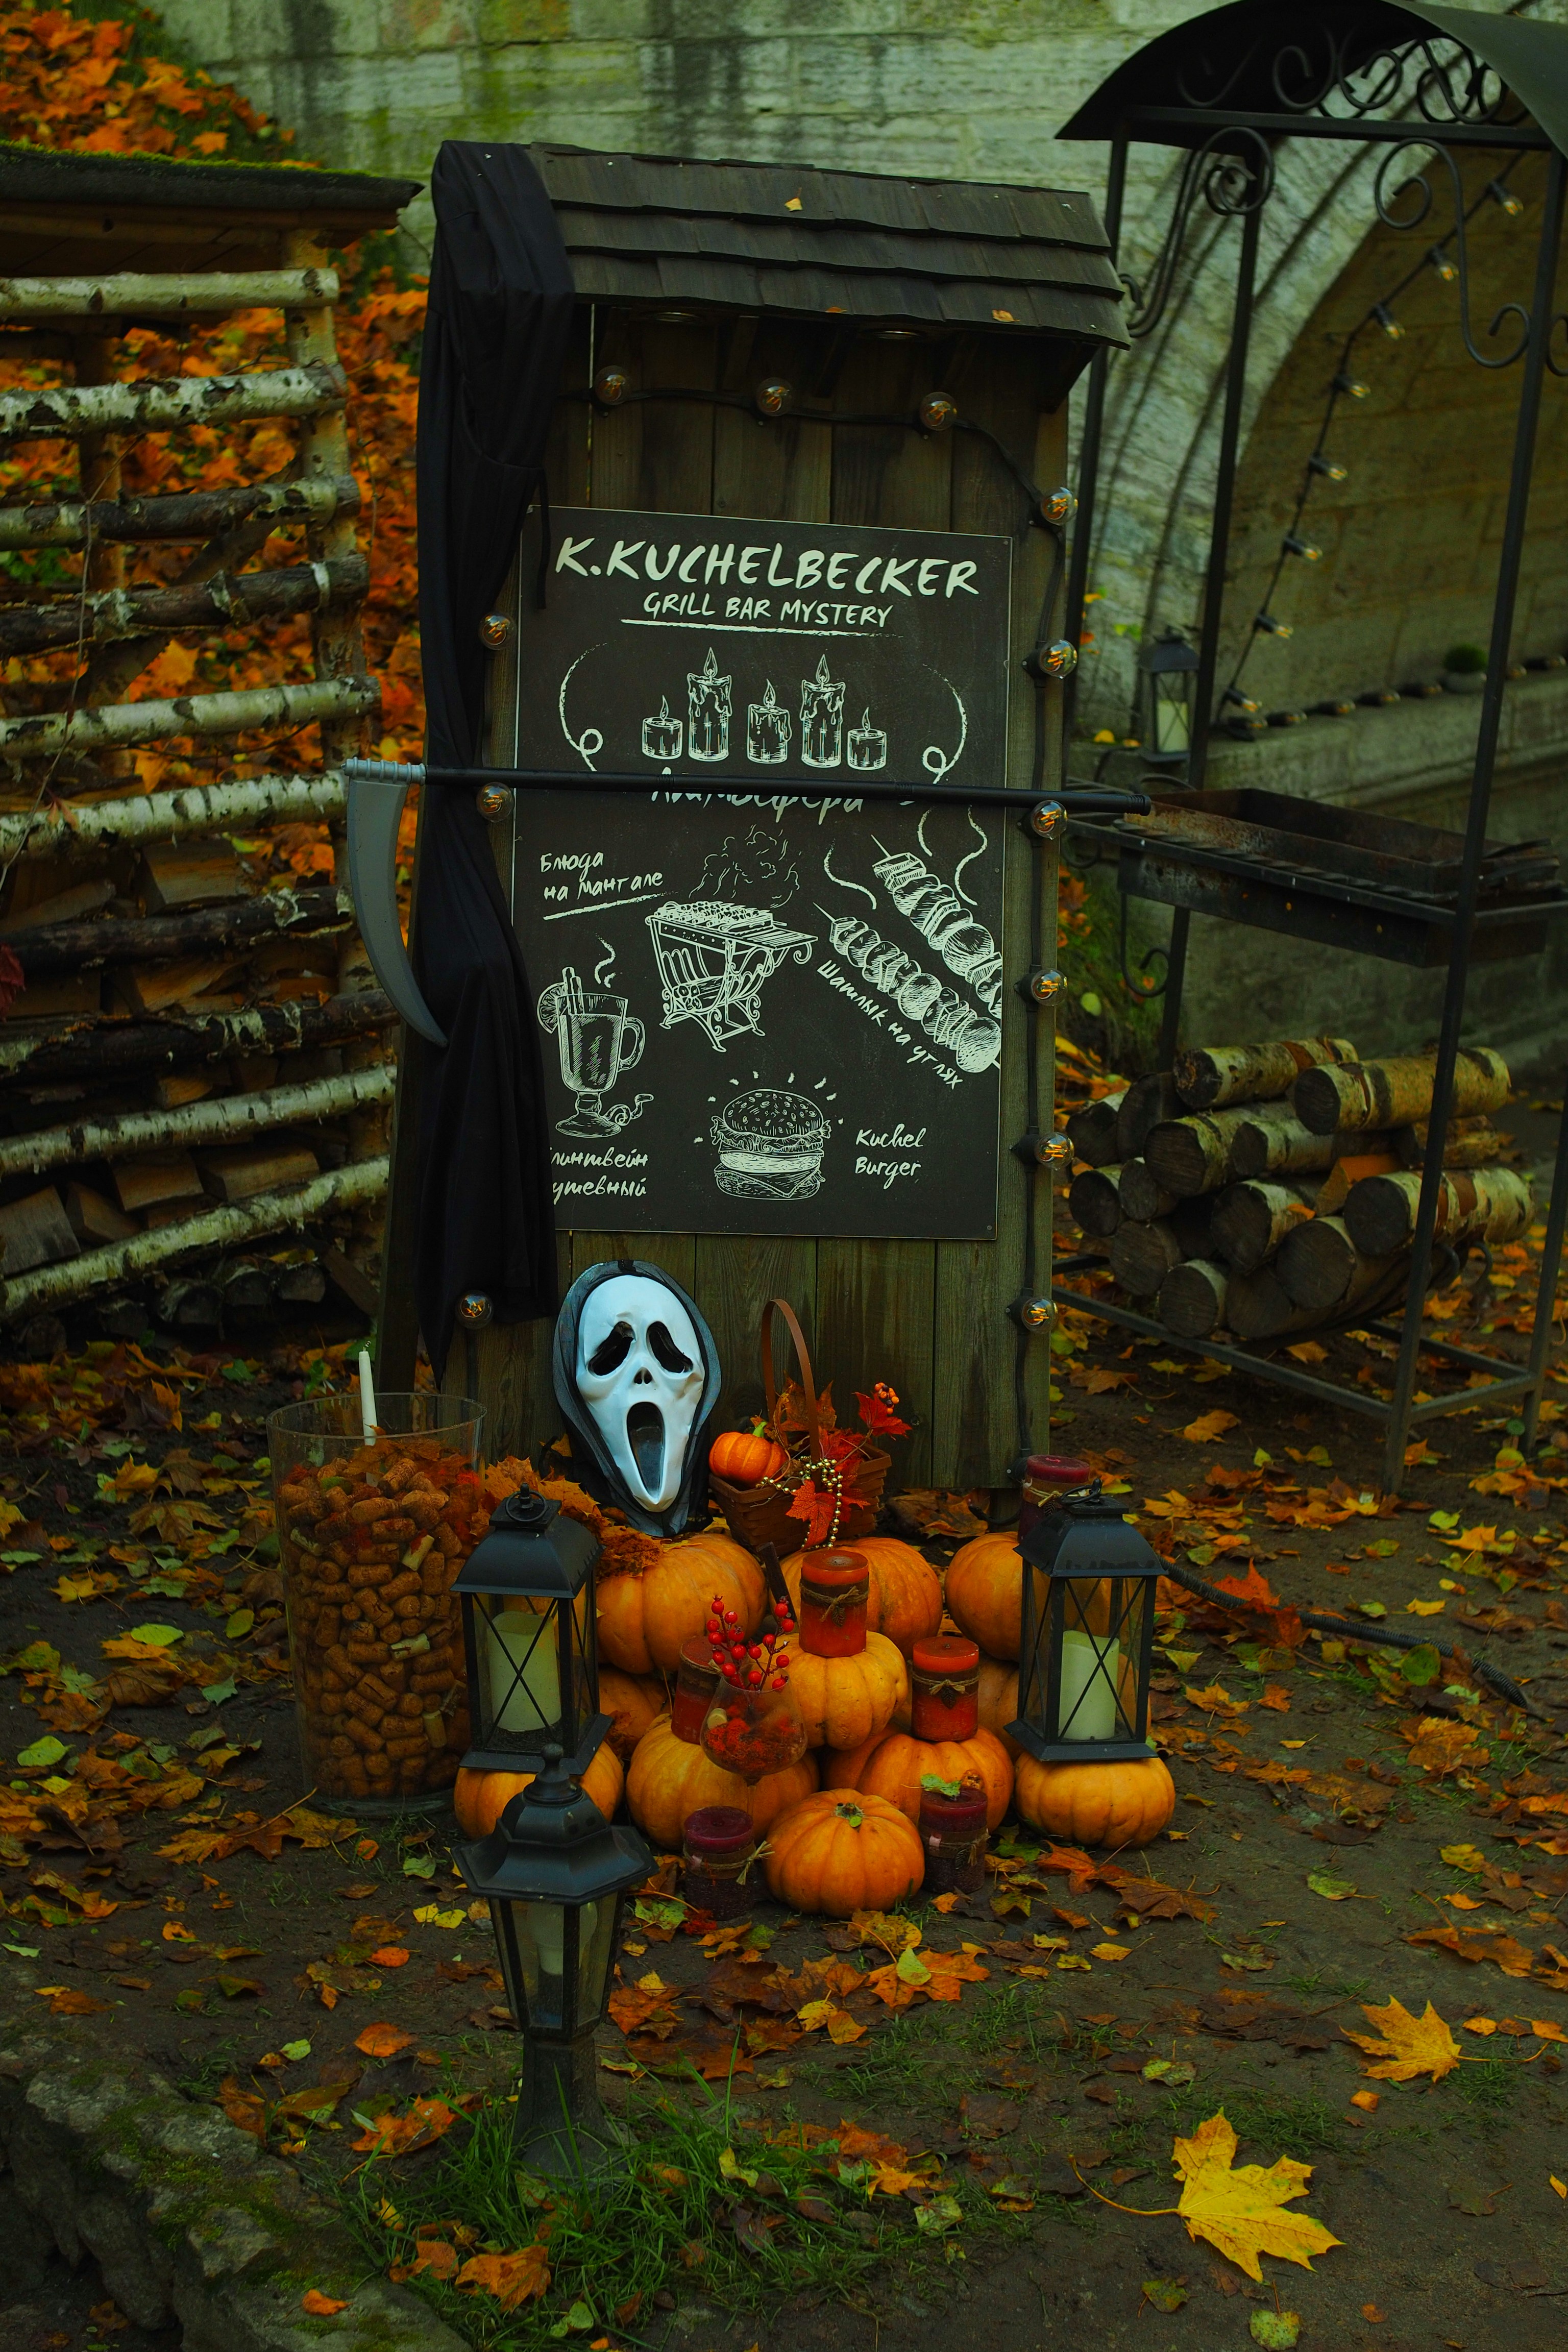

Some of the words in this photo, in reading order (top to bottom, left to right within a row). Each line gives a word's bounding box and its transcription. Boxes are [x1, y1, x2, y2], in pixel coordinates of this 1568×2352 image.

[556, 537, 979, 598] K.KUCHELBECKER
[644, 592, 716, 619] GRILL
[725, 597, 772, 620] BAR
[780, 599, 893, 628] MYSTERY
[540, 851, 604, 883] Блюда
[544, 886, 569, 901] на
[888, 1022, 912, 1046] на
[906, 1045, 964, 1090] углях
[855, 1123, 927, 1148] Kuchel
[549, 1146, 649, 1168] линтвейн
[855, 1156, 922, 1190] Burger
[552, 1175, 647, 1206] ушевный
